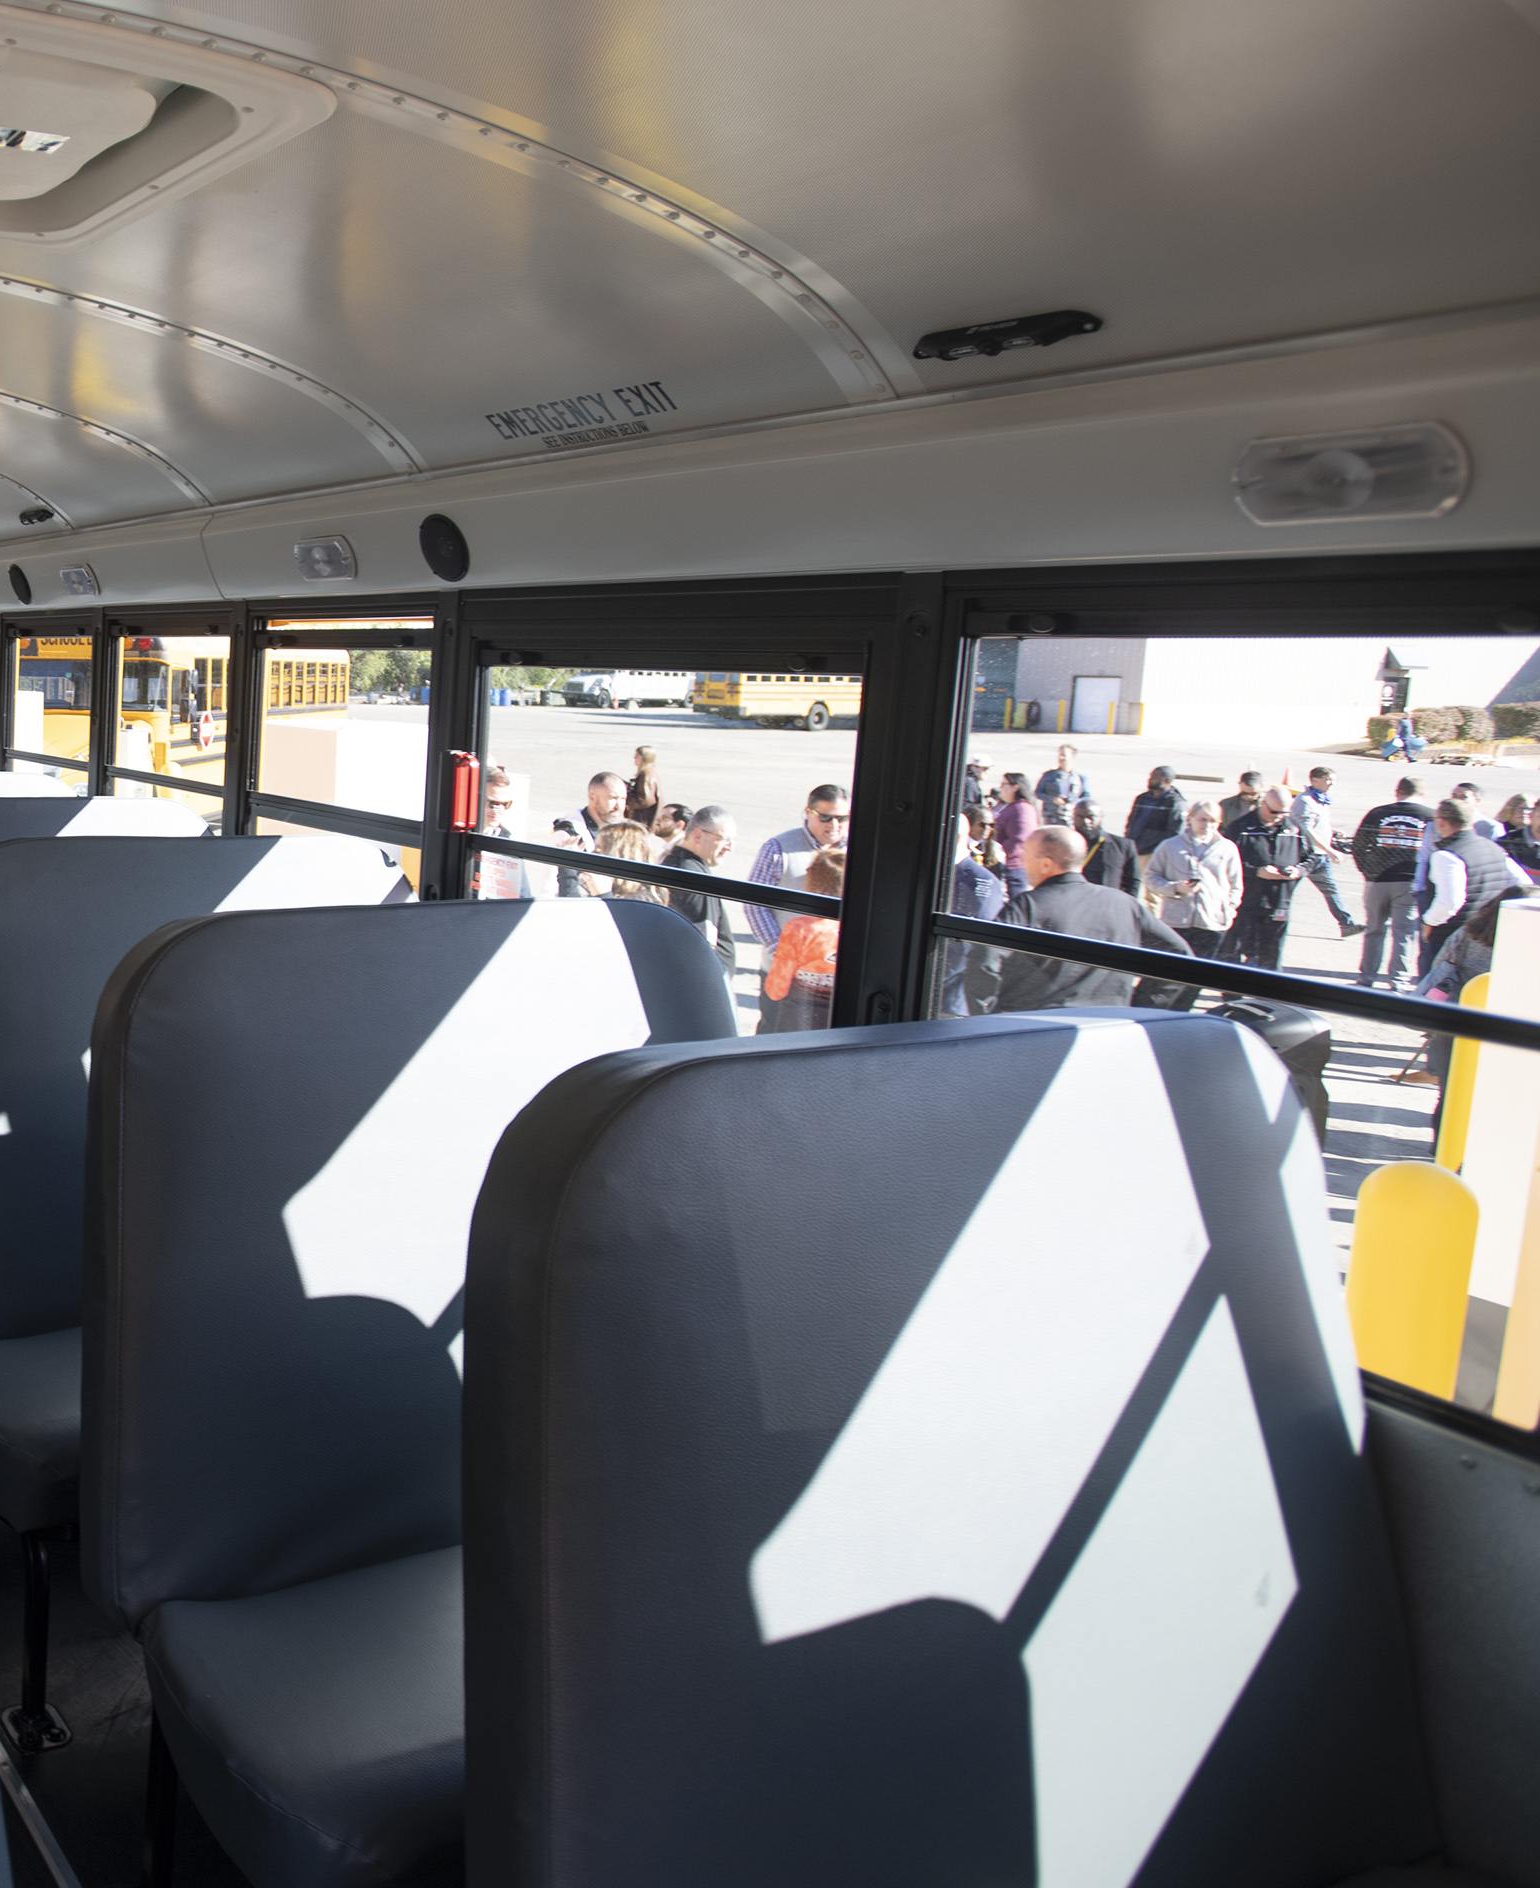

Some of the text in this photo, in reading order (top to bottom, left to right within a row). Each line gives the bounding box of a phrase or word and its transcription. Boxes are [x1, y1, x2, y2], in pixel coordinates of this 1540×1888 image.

[485, 381, 678, 440] EMERGENCY EXIT
[542, 420, 650, 448] SEE INSTRUCTIONS BELOW
